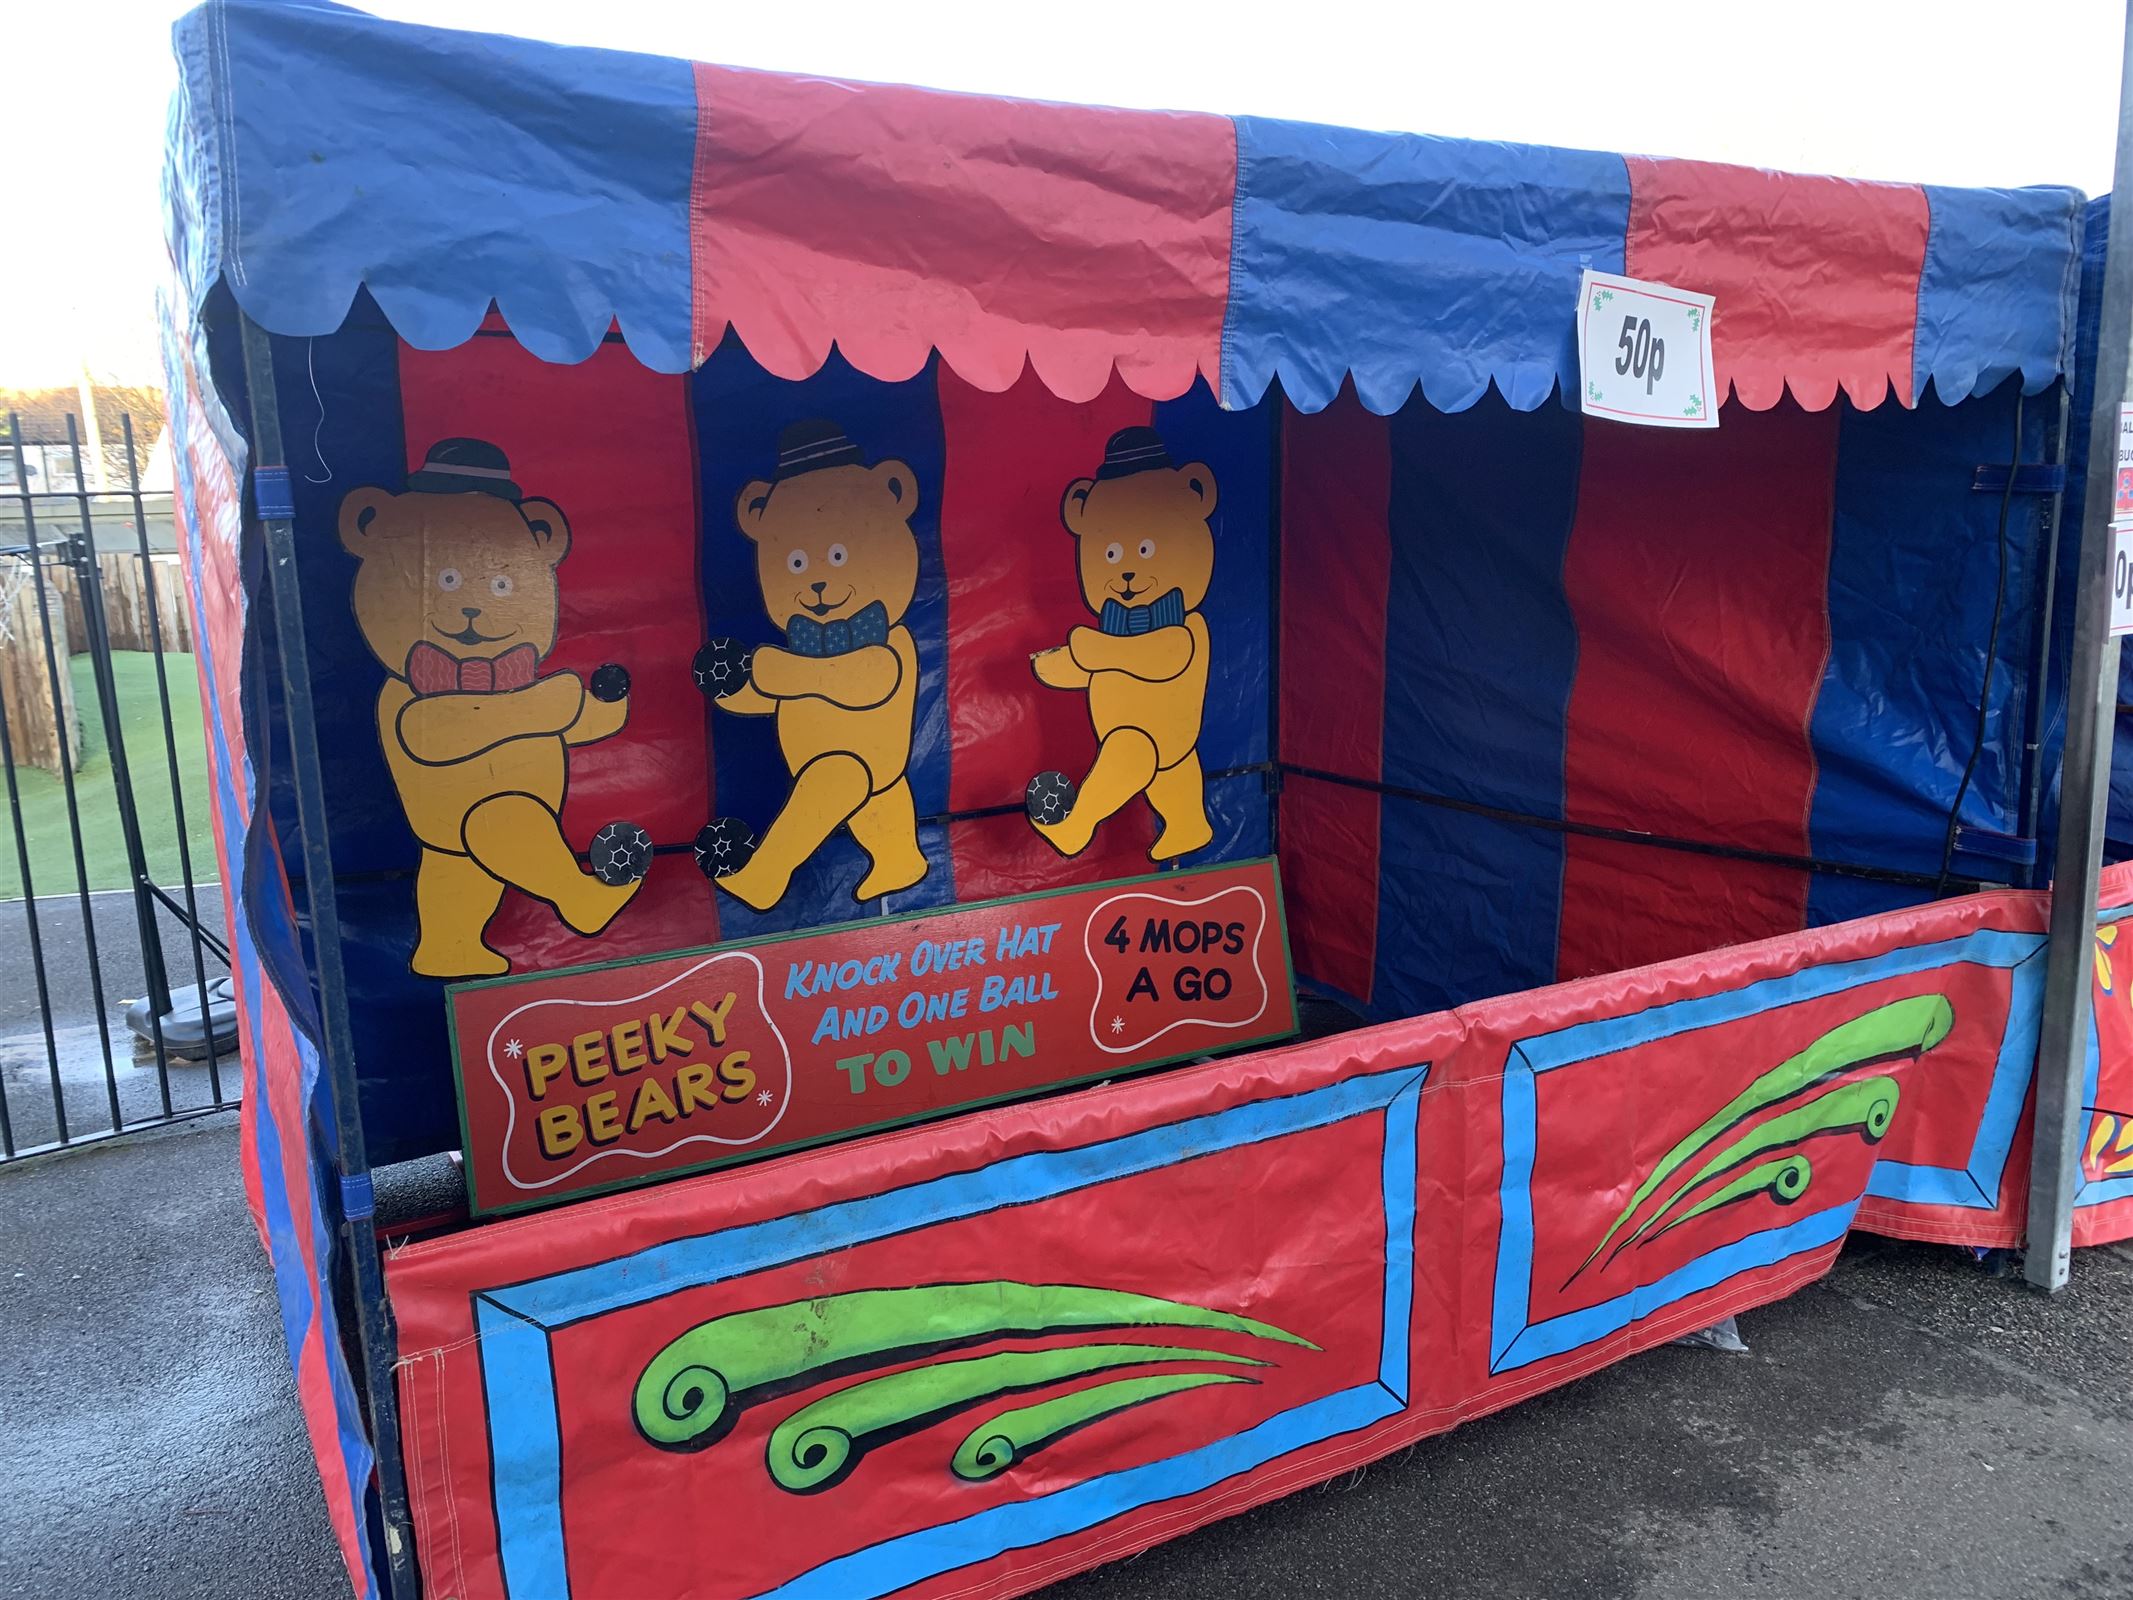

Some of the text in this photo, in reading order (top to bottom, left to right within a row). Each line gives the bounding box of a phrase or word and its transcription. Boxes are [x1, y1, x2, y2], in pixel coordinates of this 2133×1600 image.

[1615, 315, 1665, 395] 50p
[784, 923, 1061, 1000] KNOCK OVER HAT
[1105, 915, 1245, 954] 4 MOPS
[811, 973, 1059, 1045] AND ONE BALL
[1126, 966, 1232, 1003] A GO
[523, 992, 737, 1100] PEEKY
[836, 1021, 1035, 1094] TO WIN
[536, 1051, 756, 1161] BEARS
